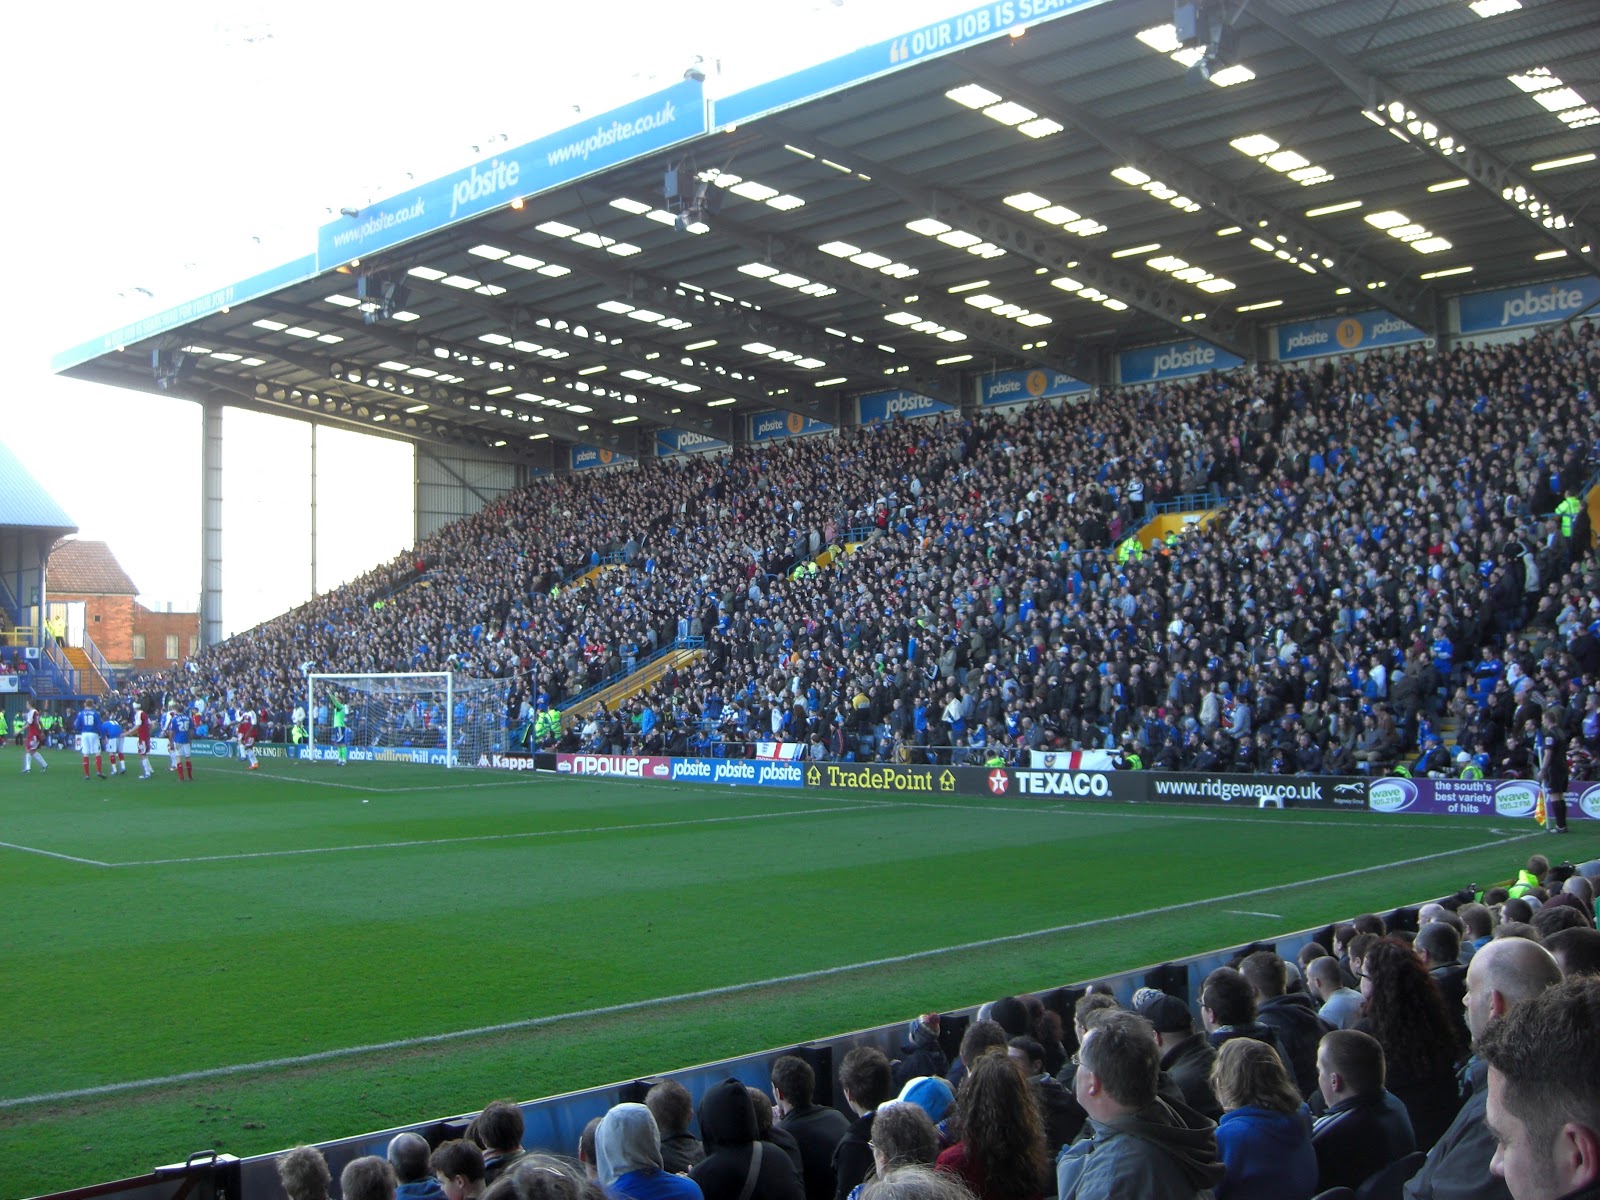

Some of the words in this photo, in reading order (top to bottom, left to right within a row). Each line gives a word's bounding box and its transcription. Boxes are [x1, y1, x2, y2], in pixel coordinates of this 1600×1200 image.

[912, 26, 951, 55] OUR
[955, 11, 990, 43] JOB
[996, 2, 1015, 26] IS
[547, 102, 676, 167] www.jobsite.co.uk
[450, 159, 519, 218] jobsite
[333, 197, 425, 249] www.jobsite.co.uk
[1501, 287, 1583, 326] jobsite
[1287, 332, 1328, 352] jobsite
[1152, 345, 1216, 378] jobsite
[989, 381, 1021, 398] jobsite
[885, 393, 934, 419] jobsite
[758, 420, 783, 435] jobsite
[576, 451, 597, 464] jobsite
[83, 715, 95, 726] 18
[177, 720, 190, 732] 26
[263, 747, 277, 758] KING
[300, 748, 322, 760] jobite
[375, 749, 458, 765] williamhillcom
[492, 755, 534, 770] Kappa
[672, 759, 711, 780] jobsite
[714, 760, 755, 782] jobsite
[758, 762, 802, 784] jobsite
[827, 766, 933, 790] TradePoint
[1015, 771, 1109, 796] TEXACO
[1156, 779, 1323, 801] www.ridgeway.co.uk
[1435, 781, 1453, 791] the
[1454, 781, 1492, 791] south's
[1371, 789, 1401, 798] wave
[1374, 797, 1391, 805] 105.2
[1391, 796, 1402, 804] FM
[1435, 791, 1457, 801] best
[1458, 792, 1492, 804] variety
[1496, 791, 1530, 802] wave
[1448, 803, 1459, 813] of
[1461, 804, 1479, 813] hits
[1499, 801, 1518, 811] 105.2
[1518, 800, 1531, 809] FM
